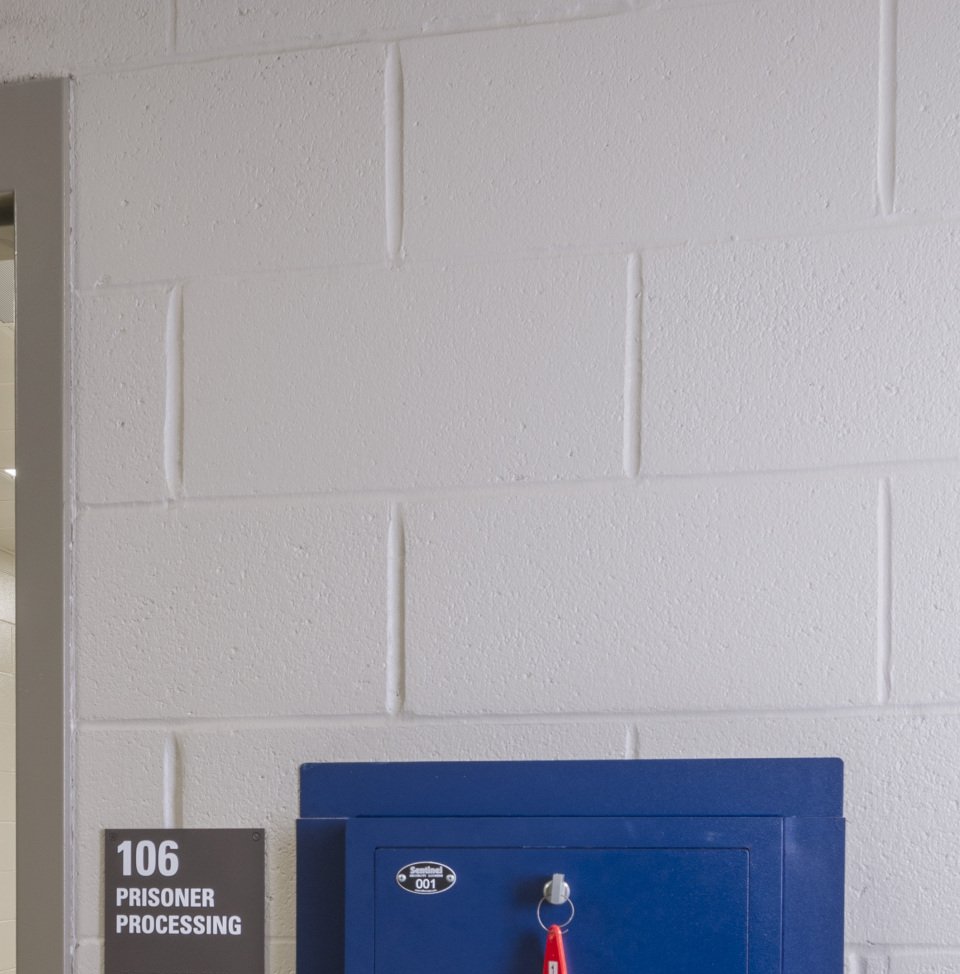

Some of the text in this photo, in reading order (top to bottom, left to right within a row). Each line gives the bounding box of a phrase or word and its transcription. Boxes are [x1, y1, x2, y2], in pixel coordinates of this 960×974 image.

[117, 840, 179, 876] 106
[409, 865, 443, 875] Sentinel
[415, 878, 436, 889] 001
[116, 888, 215, 907] PRISONER
[116, 914, 242, 935] PROCESSING
